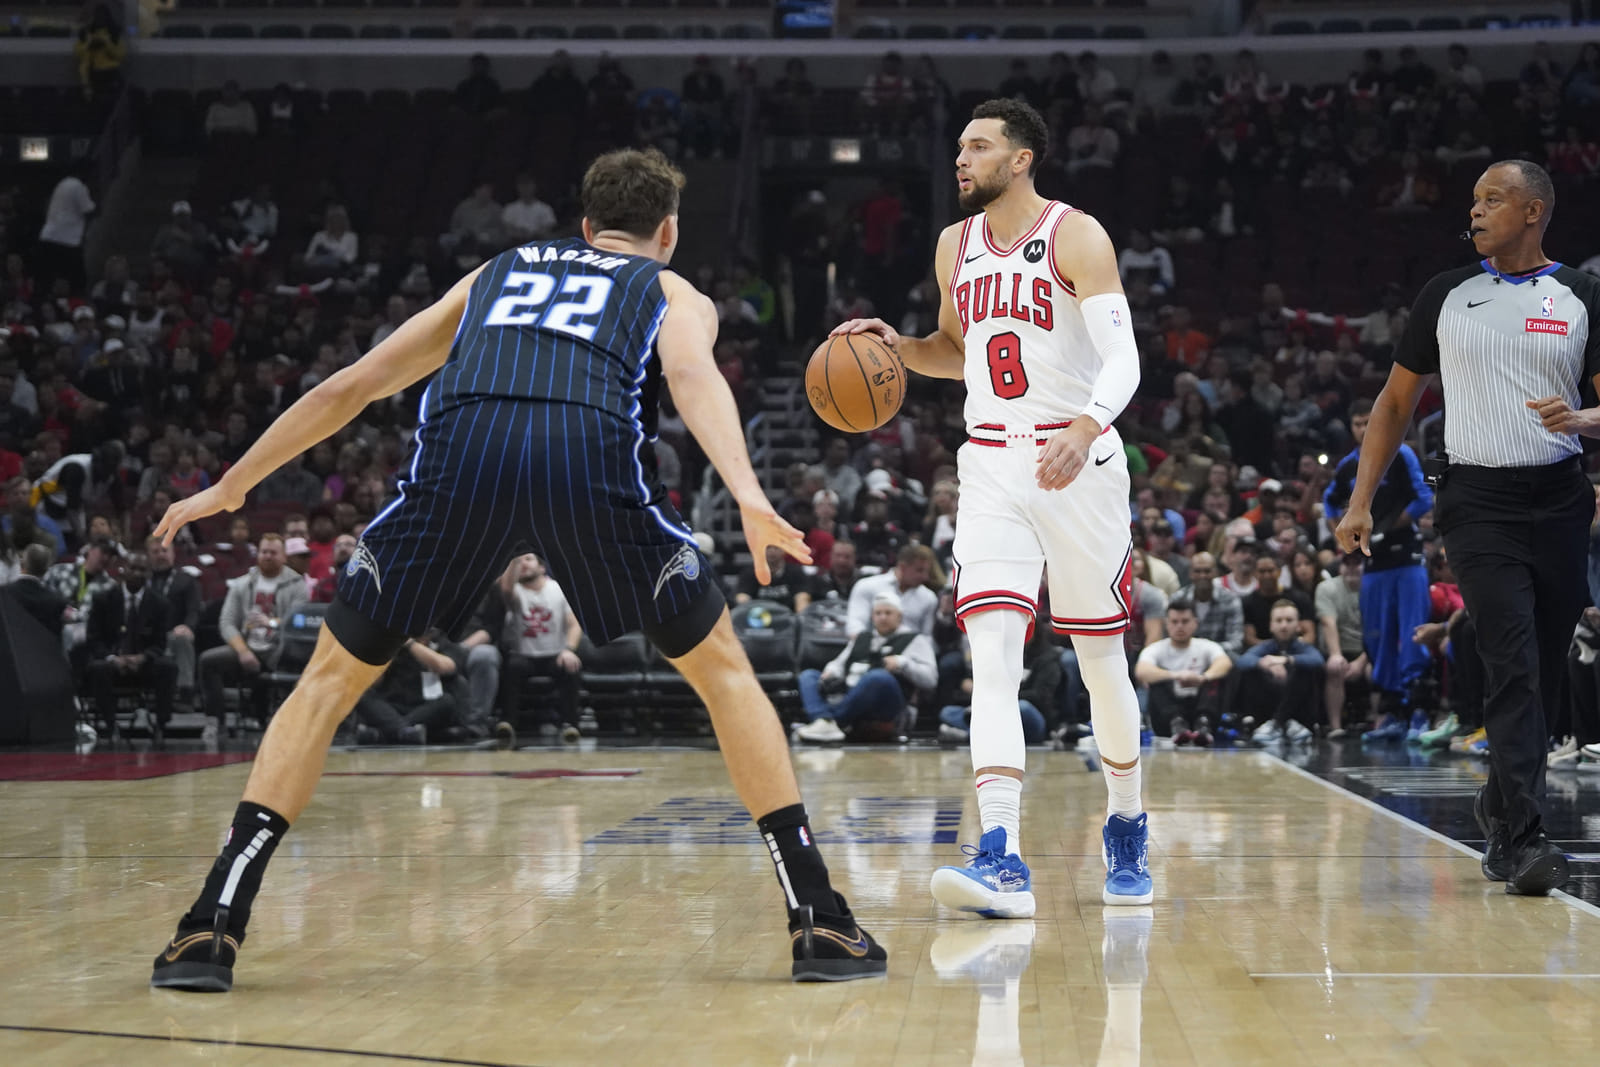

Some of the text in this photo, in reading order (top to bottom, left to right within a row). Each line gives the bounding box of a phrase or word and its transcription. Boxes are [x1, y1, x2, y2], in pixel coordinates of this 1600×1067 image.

[483, 271, 615, 340] 22
[956, 272, 1054, 338] BULLS
[1527, 320, 1567, 333] Emirates
[987, 331, 1030, 400] 8
